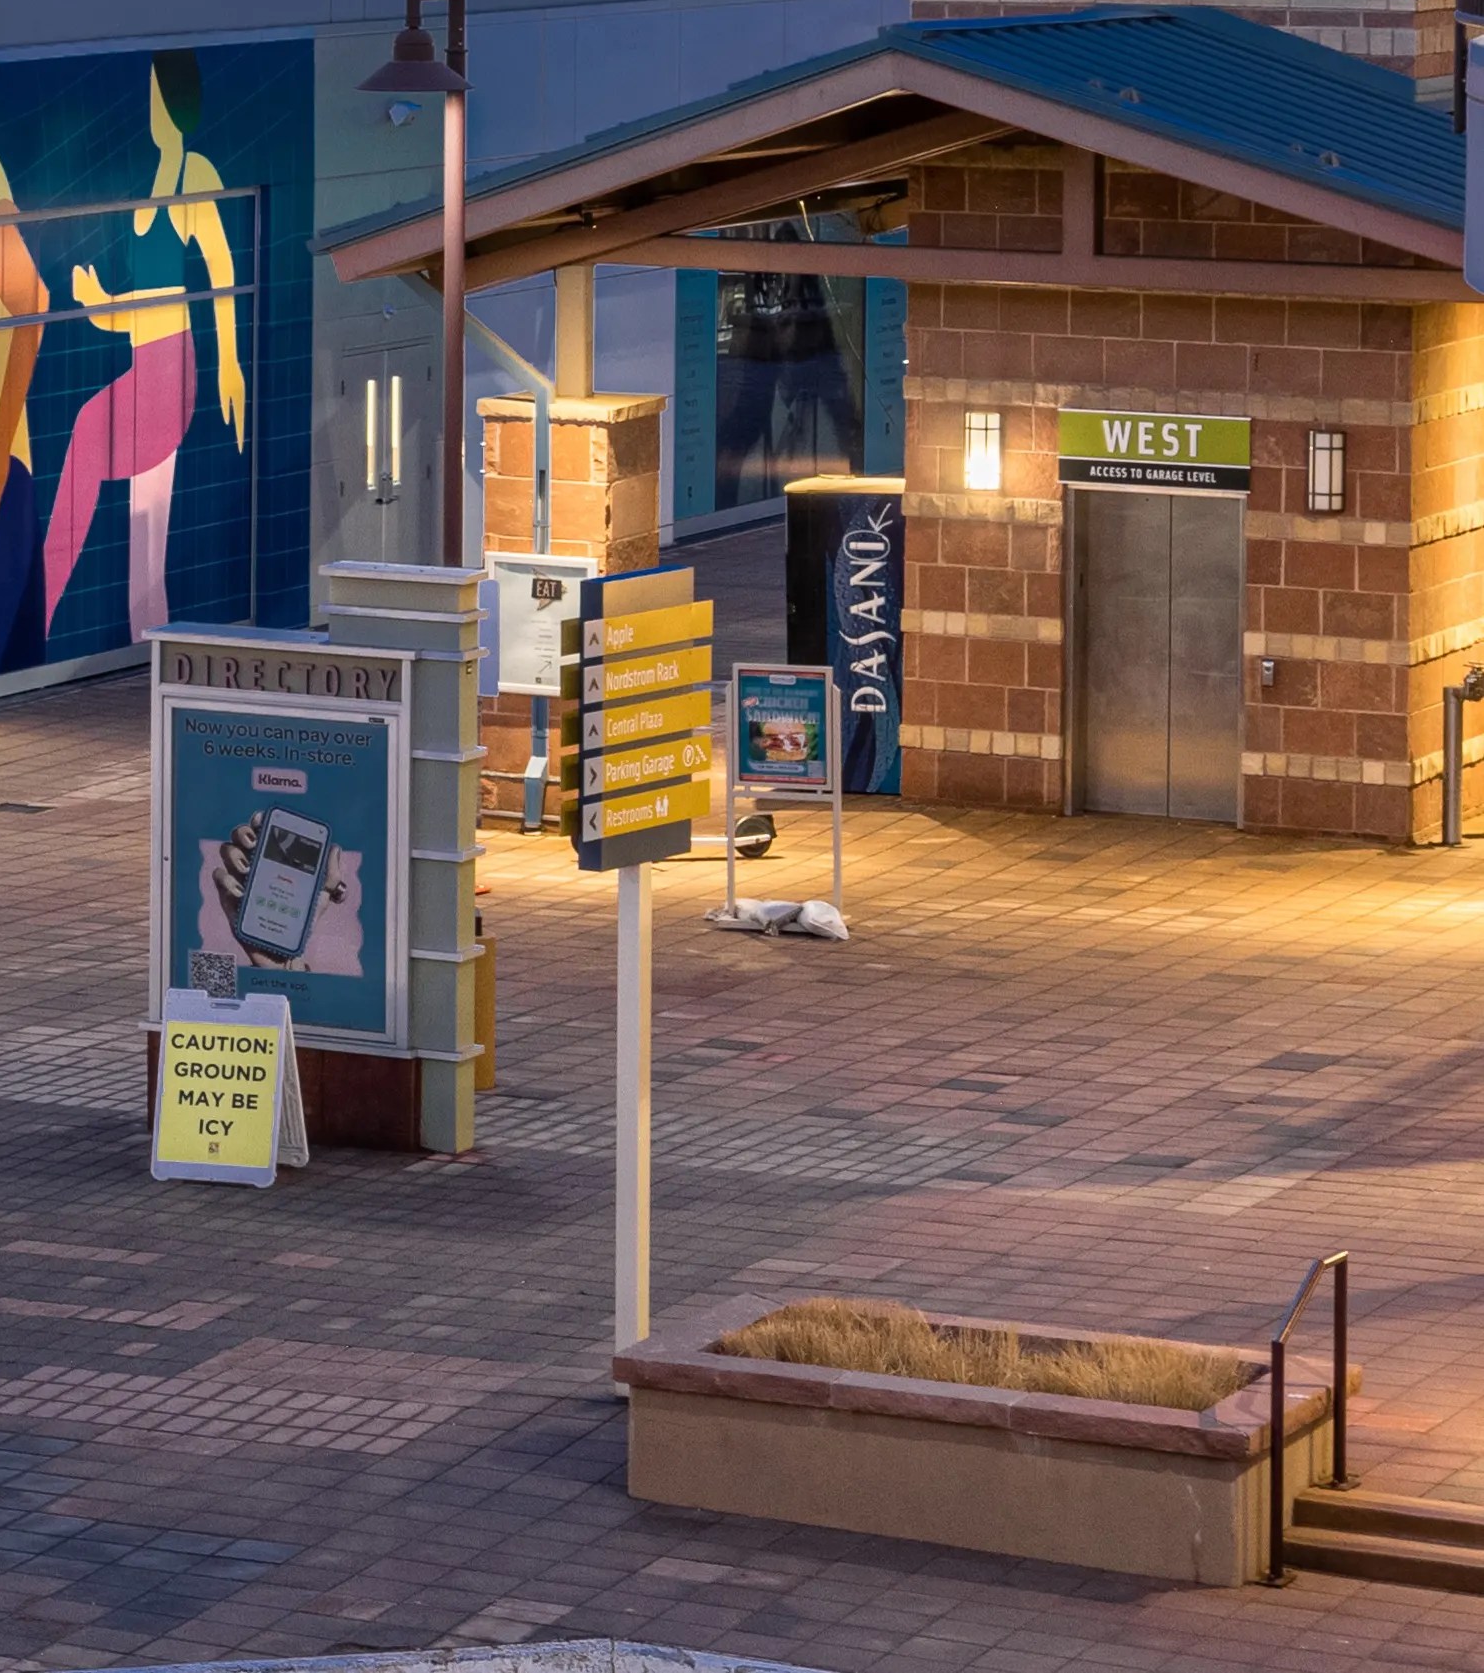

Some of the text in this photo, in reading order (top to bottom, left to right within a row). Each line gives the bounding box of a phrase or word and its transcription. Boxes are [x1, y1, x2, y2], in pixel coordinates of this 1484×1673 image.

[1102, 419, 1203, 458] WEST
[1089, 465, 1217, 484] ACCESS TO GARAGE LEVEL
[536, 580, 558, 598] EAT
[838, 529, 897, 712] DASANI
[606, 623, 634, 650] Apple
[174, 652, 397, 701] DIRECTORY
[606, 660, 680, 692] Nordstrom Rack
[185, 717, 372, 747] Now you can pay over
[607, 711, 664, 737] Central Plaza
[204, 740, 357, 766] 6 weeks. In-store.
[257, 773, 303, 789] Klarna.
[605, 760, 641, 783] Parking
[642, 754, 675, 776] Garage
[606, 804, 653, 826] Restrooms
[171, 1033, 274, 1055] CAUTION:
[174, 1061, 267, 1082] GROUND
[178, 1089, 259, 1110] MAY BE
[198, 1118, 234, 1136] ICY
